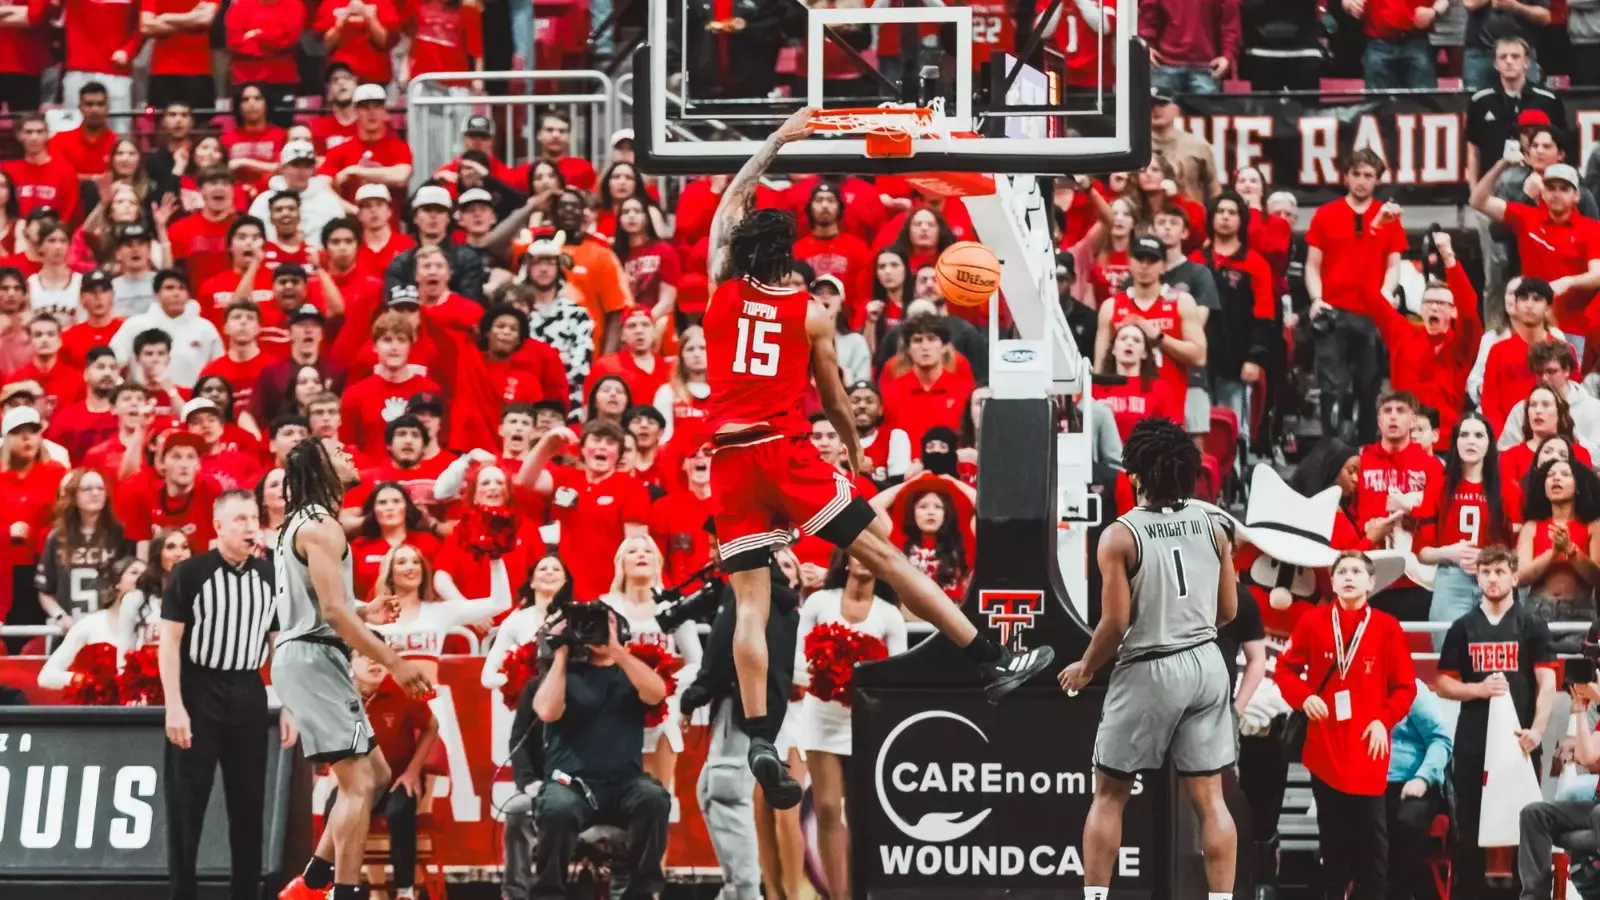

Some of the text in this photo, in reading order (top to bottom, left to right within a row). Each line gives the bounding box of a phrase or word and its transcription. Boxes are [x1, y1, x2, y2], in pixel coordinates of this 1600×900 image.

[972, 17, 1002, 44] 22
[1066, 15, 1077, 53] 1
[1173, 112, 1468, 186] HE RAID
[956, 270, 995, 287] Wilson
[742, 301, 778, 319] TOPPIN
[732, 318, 781, 376] 15
[1144, 520, 1203, 538] WRIGHT III
[1460, 505, 1480, 546] 9
[70, 567, 99, 613] 5
[1171, 546, 1189, 598] 1
[1468, 641, 1519, 673] TECH
[891, 761, 1144, 796] CAREnomis
[0, 765, 158, 849] UIS
[879, 844, 1141, 877] WOUNDCAE
